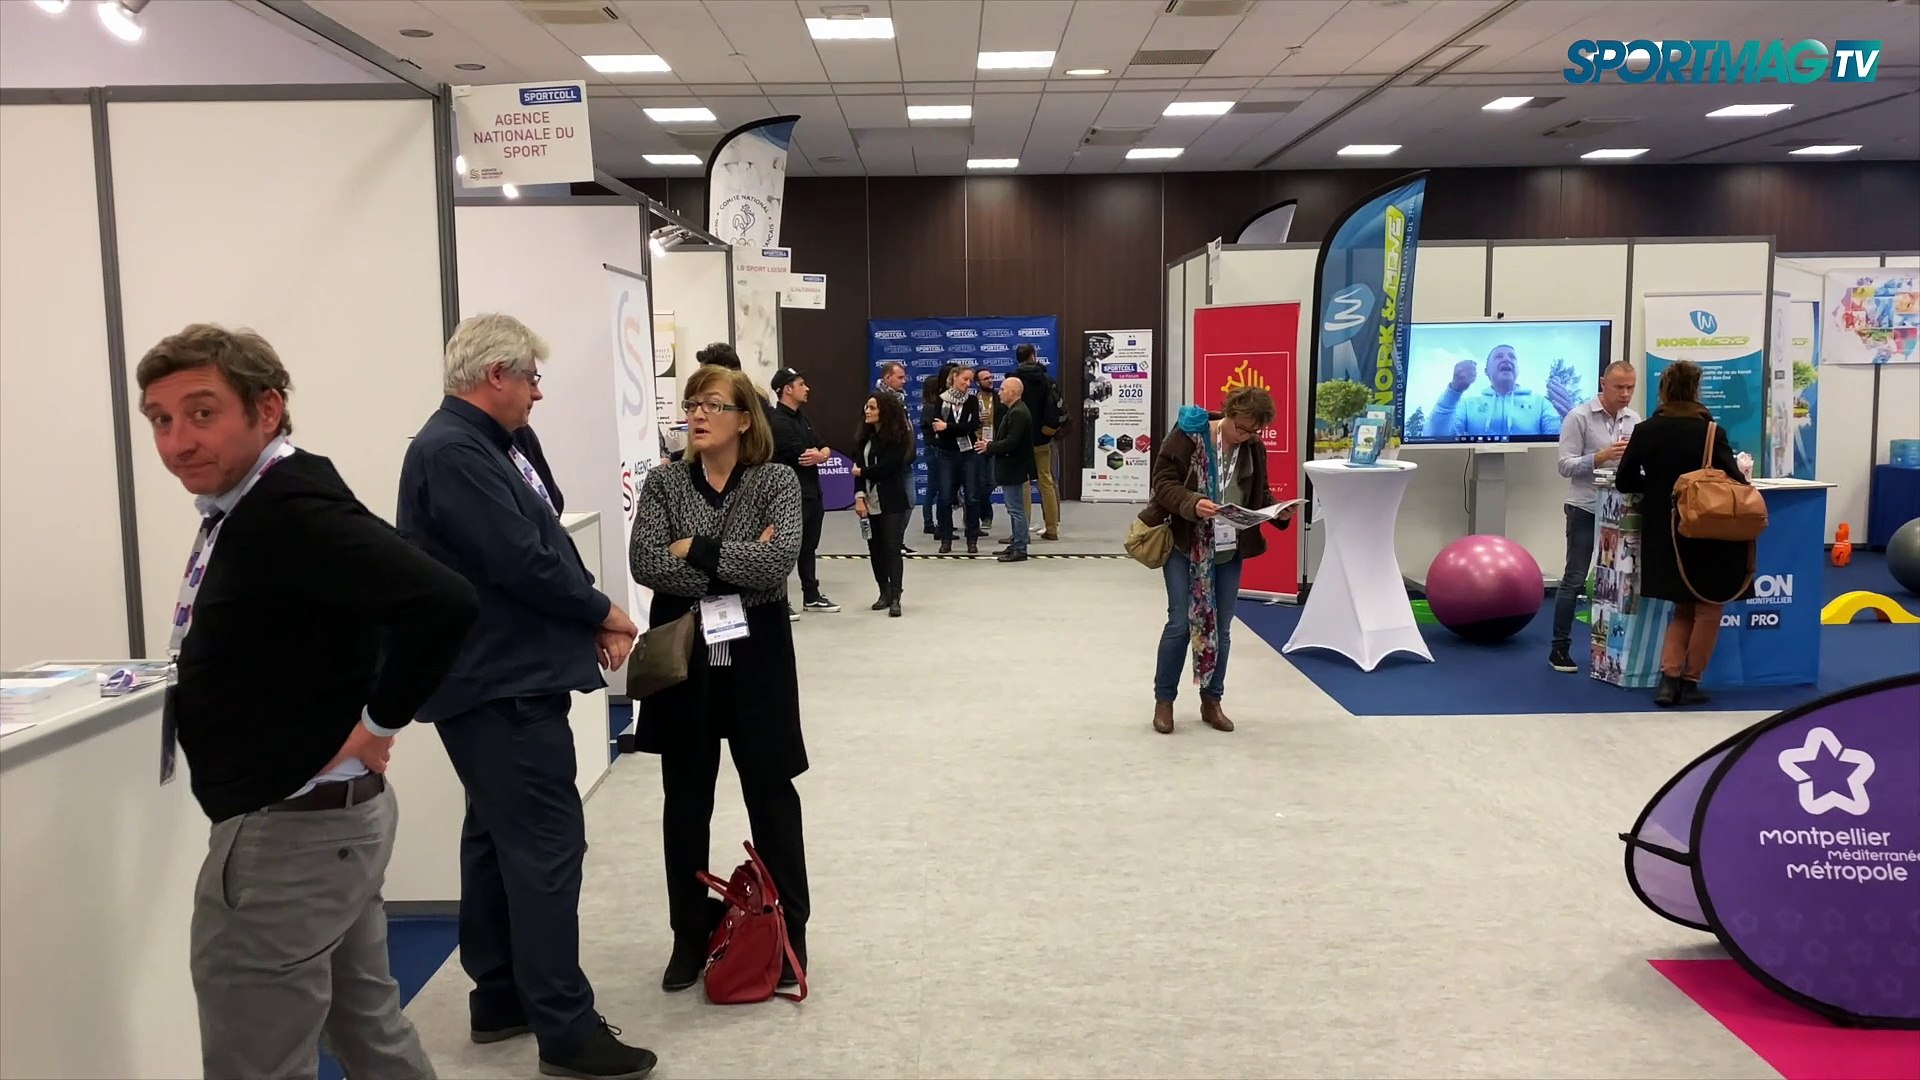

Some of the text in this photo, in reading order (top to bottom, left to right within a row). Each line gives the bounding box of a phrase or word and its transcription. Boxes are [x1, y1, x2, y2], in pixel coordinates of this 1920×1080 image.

[524, 90, 578, 102] SPORTCOLL
[495, 111, 550, 126] AGENCE
[474, 126, 574, 144] NATIONALE DU
[503, 144, 548, 158] SPORT
[741, 194, 769, 213] NATIONAL
[875, 331, 907, 339] SPORTCOLL
[946, 330, 979, 338] SPORTCOLL
[1018, 329, 1050, 337] SPORTCOLL
[1119, 389, 1143, 398] 2020
[1746, 596, 1792, 604] MONTPELLIER
[1751, 613, 1779, 626] PRO
